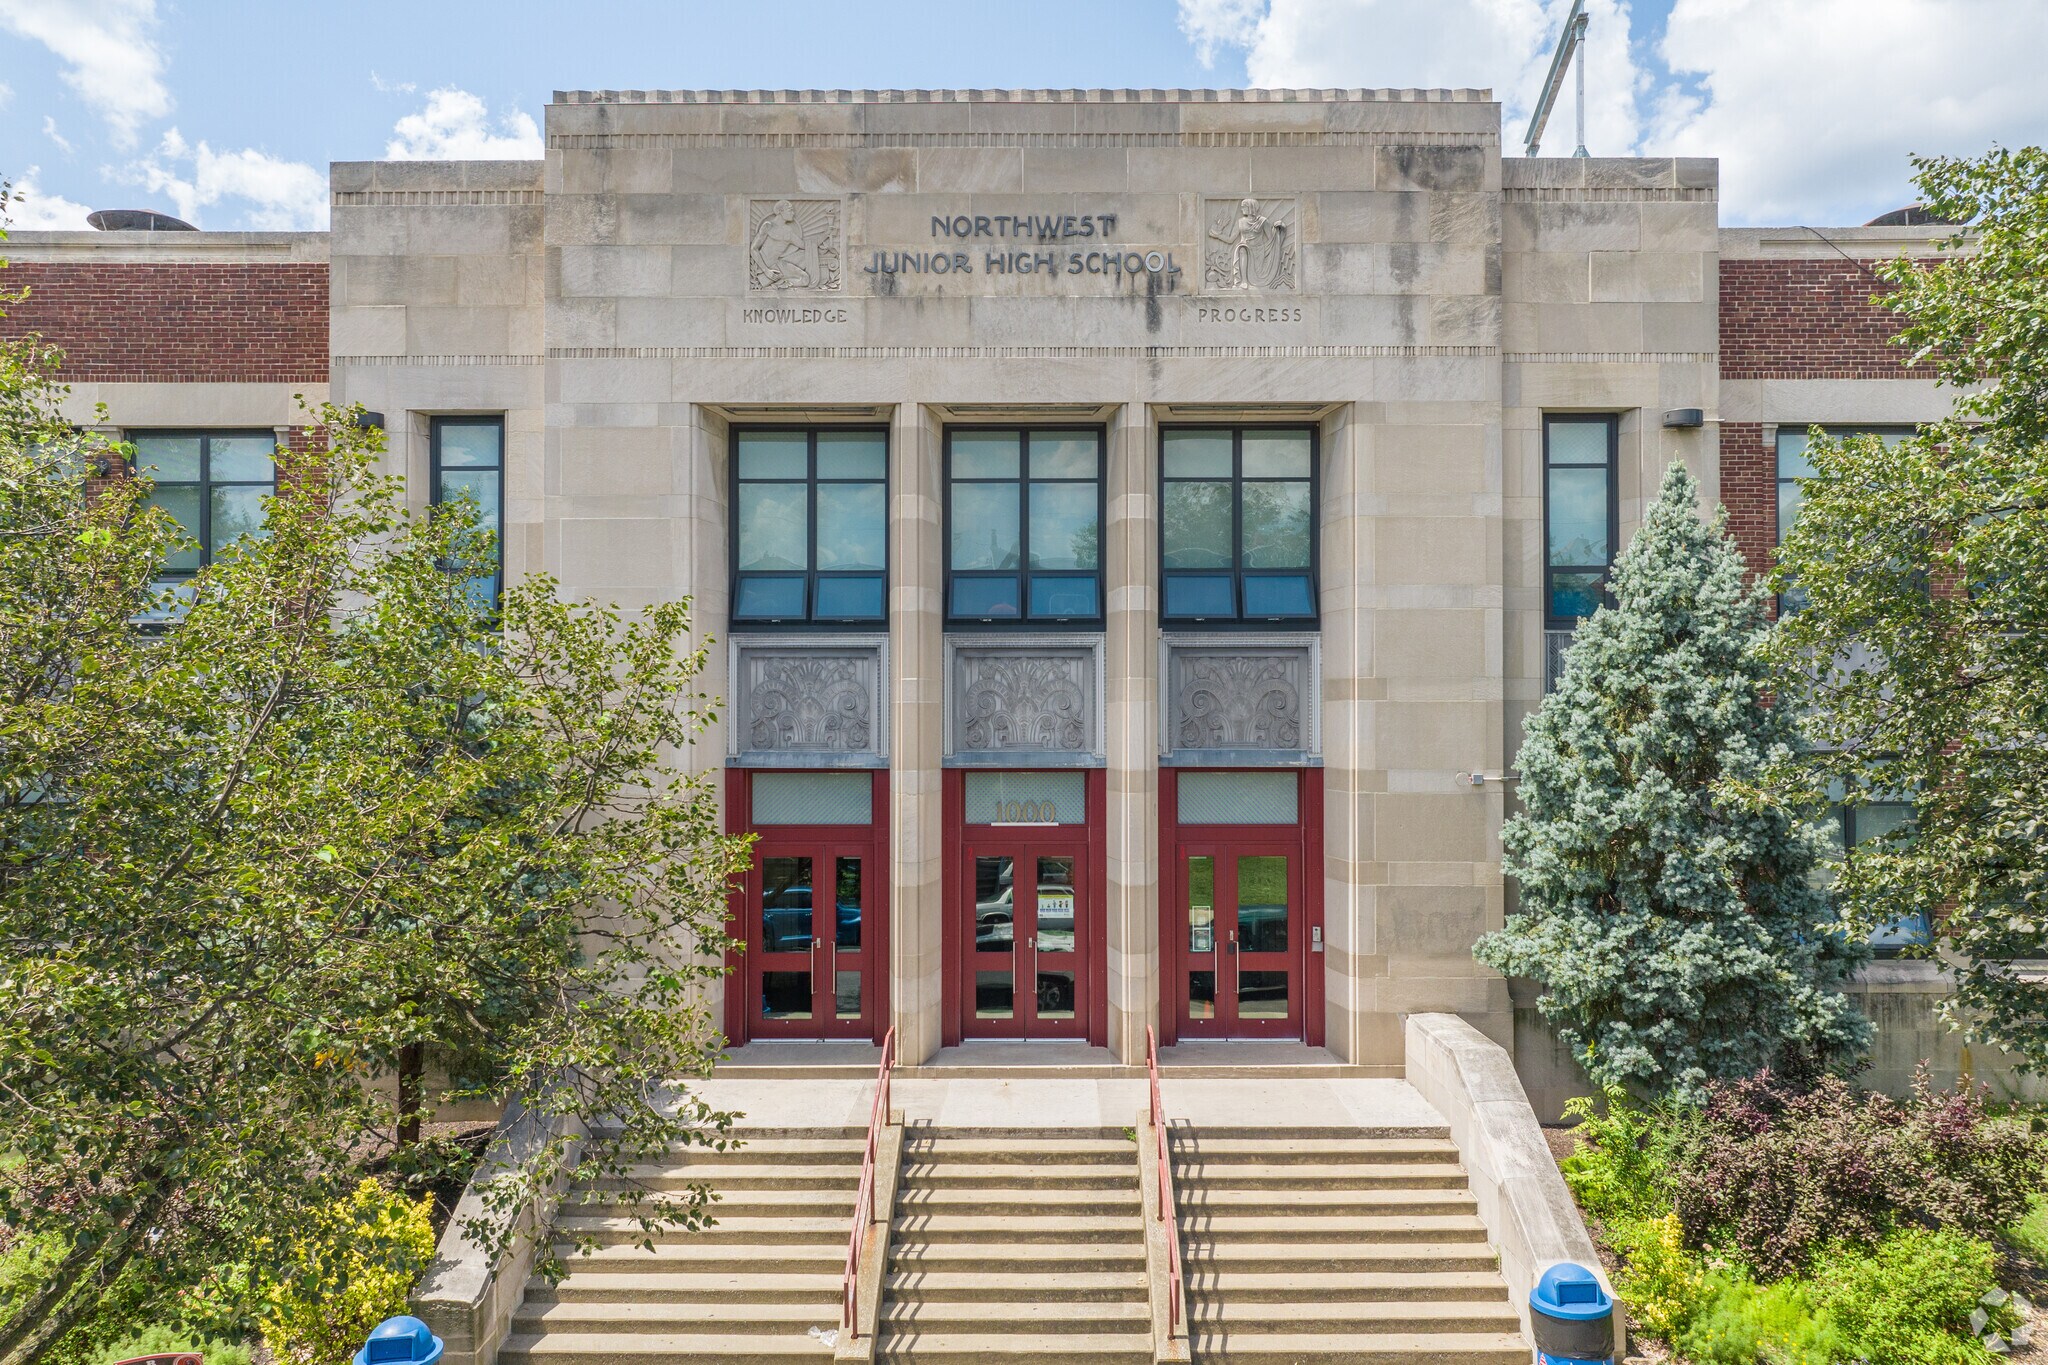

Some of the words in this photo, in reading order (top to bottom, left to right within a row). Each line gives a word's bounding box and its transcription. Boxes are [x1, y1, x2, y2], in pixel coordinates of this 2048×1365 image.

[931, 215, 1115, 236] NORTHWEST
[864, 252, 972, 273] JUNIOR
[986, 252, 1055, 273] HIGH
[1067, 251, 1181, 273] SCHOOL
[743, 309, 847, 324] KNOWLEDGE
[1199, 308, 1302, 323] PROGRESS
[996, 800, 1056, 823] 1000
